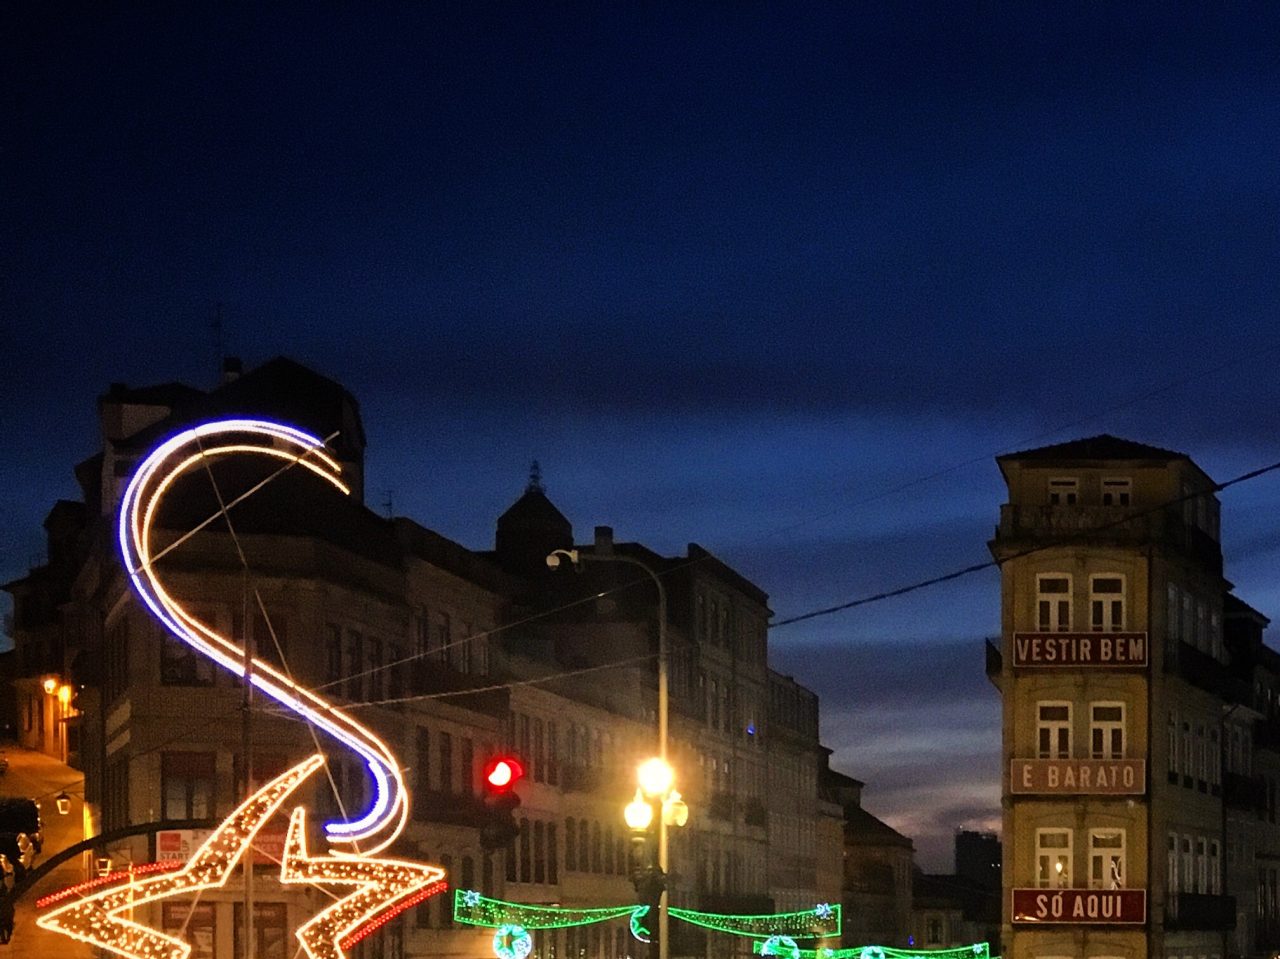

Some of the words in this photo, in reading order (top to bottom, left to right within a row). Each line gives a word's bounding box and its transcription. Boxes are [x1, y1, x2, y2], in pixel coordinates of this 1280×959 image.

[1017, 638, 1091, 661] VESTIR
[1100, 638, 1144, 661] BEM
[1023, 764, 1033, 788] E
[1048, 766, 1134, 788] BARATO
[160, 852, 190, 860] START
[1036, 891, 1063, 918] SÓ
[1072, 894, 1122, 918] AQUI
